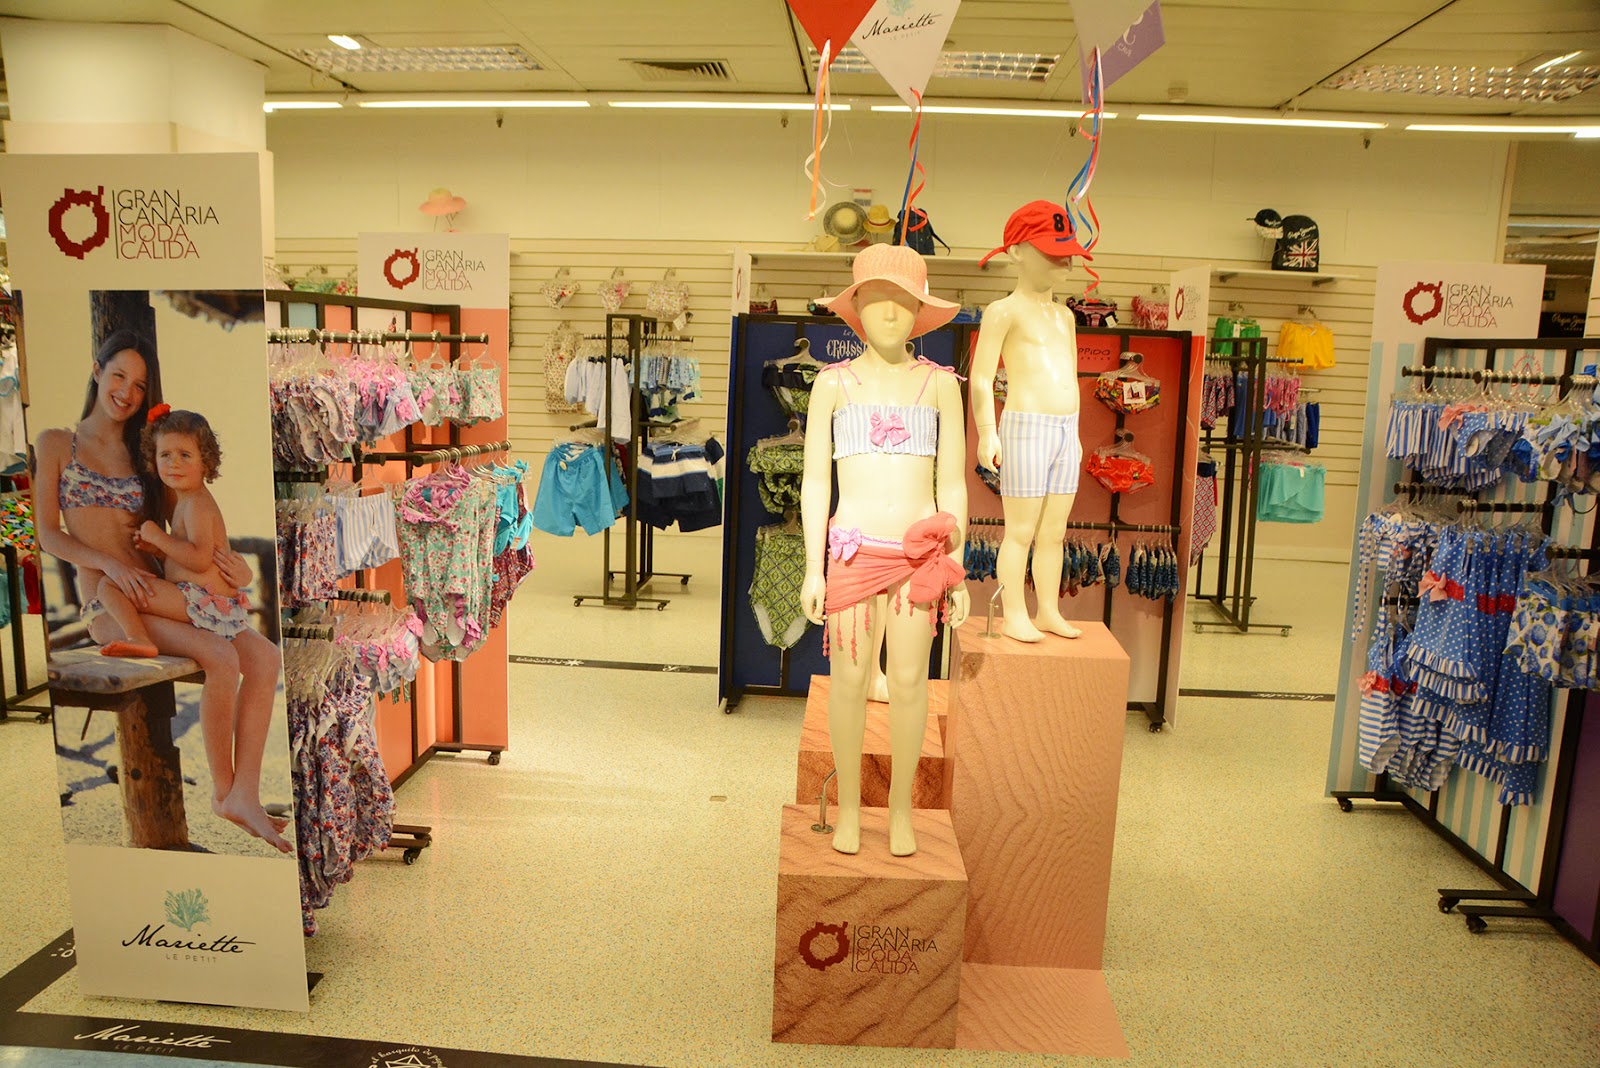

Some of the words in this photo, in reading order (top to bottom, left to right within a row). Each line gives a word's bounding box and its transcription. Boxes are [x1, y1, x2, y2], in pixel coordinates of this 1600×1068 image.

[862, 13, 942, 40] Mariette
[117, 189, 180, 209] GRAN
[118, 206, 220, 225] CANARIA
[119, 223, 190, 242] MODA
[425, 249, 464, 261] GRAN
[425, 260, 486, 272] CANARIA
[425, 269, 467, 281] MODA
[1450, 283, 1492, 297] GRAN
[1448, 293, 1514, 308] CANARIA
[1447, 304, 1493, 318] MODA
[121, 924, 257, 954] Mariette
[857, 925, 909, 940] GRAN
[856, 936, 938, 953] CANARIA
[185, 954, 218, 963] PETIT
[856, 950, 912, 963] MODA
[74, 1024, 232, 1049] Mariette
